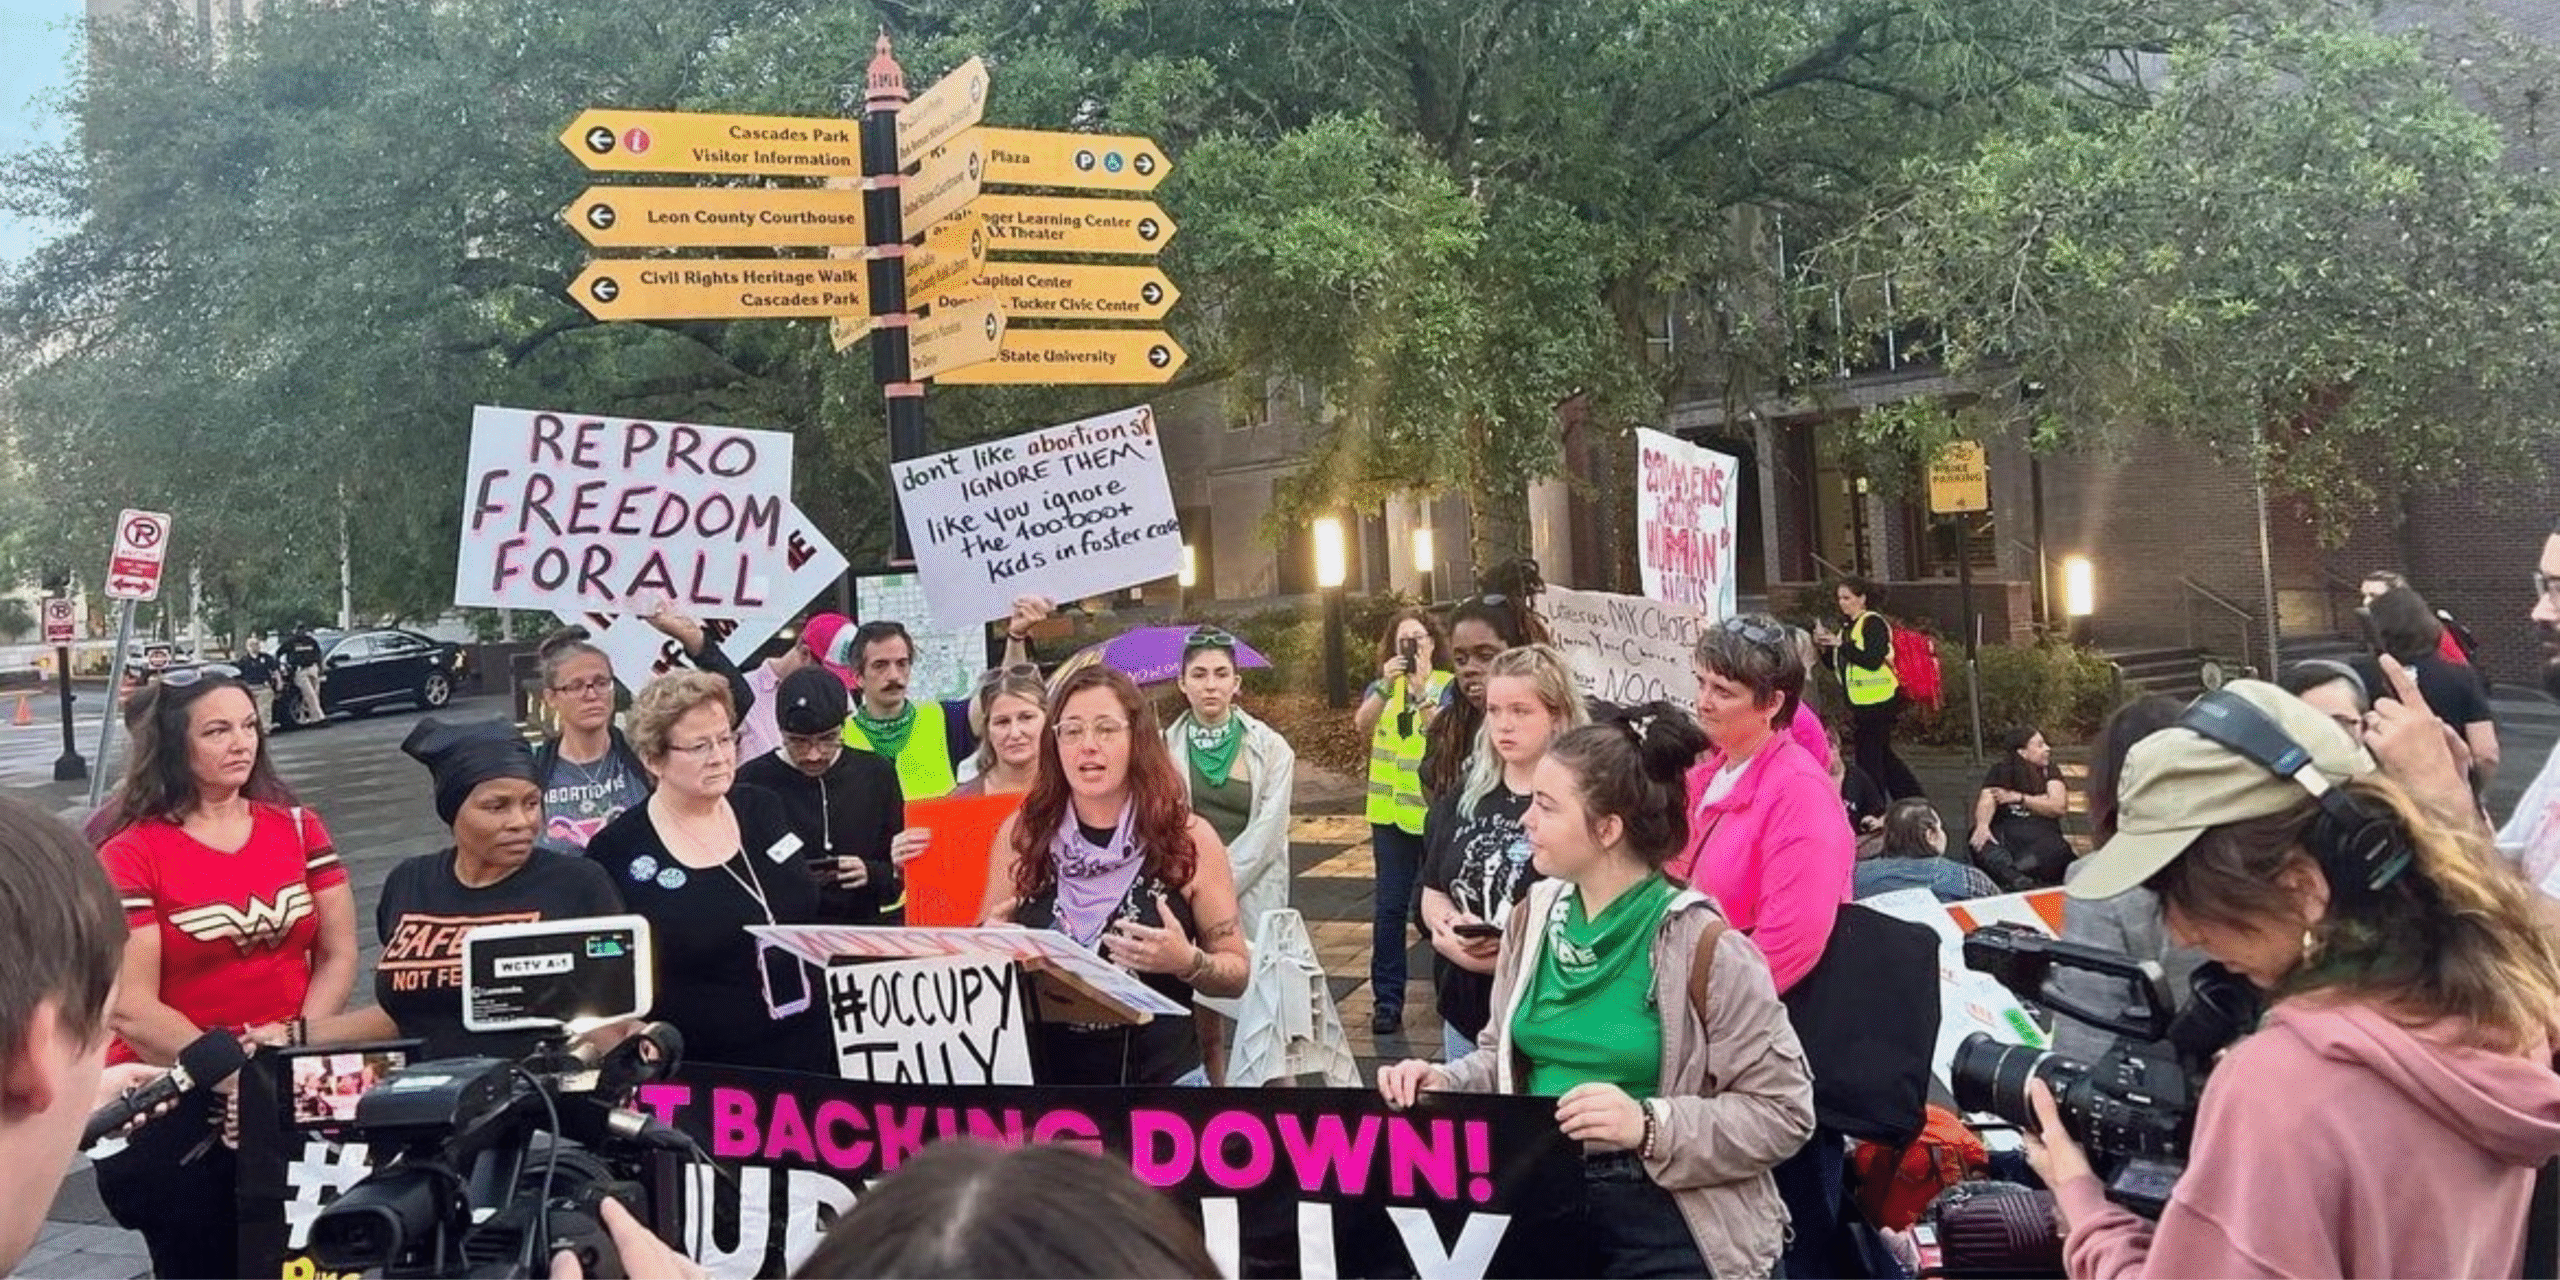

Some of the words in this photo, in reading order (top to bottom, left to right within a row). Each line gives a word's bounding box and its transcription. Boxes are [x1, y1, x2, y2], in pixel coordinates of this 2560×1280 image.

[729, 126, 808, 142] Cascades
[813, 127, 850, 143] Park
[692, 148, 750, 165] Visitor
[754, 150, 851, 167] Information
[991, 149, 1031, 165] Plaza
[647, 210, 690, 225] Leon
[694, 210, 755, 228] County
[759, 210, 855, 226] Courthouse
[1017, 212, 1082, 229] Learning
[1086, 213, 1132, 228] Center
[1010, 227, 1065, 241] Theater
[640, 270, 680, 285] Civil
[684, 270, 739, 288] Rights
[743, 269, 813, 288] Heritage
[818, 268, 858, 283] Walk
[1027, 275, 1073, 288] Center
[741, 293, 818, 307] Cascades
[822, 291, 860, 306] Park
[1011, 298, 1056, 312] Tucker
[1060, 298, 1093, 312] Civic
[1096, 299, 1141, 313] Center
[1000, 350, 1041, 363] State
[1044, 350, 1117, 366] University
[529, 413, 757, 478] REPRO
[902, 453, 962, 492] don't
[974, 446, 1017, 472] like
[961, 460, 1050, 502] IGNORE
[472, 469, 781, 547] FREEDOM
[927, 515, 980, 545] like
[984, 501, 1031, 532] you
[1043, 479, 1126, 520] ignore
[961, 534, 1012, 559] the
[1055, 544, 1077, 560] in
[1081, 526, 1142, 555] foster
[492, 538, 616, 601] FOR
[625, 550, 764, 607] ALL
[1605, 667, 1645, 703] NO
[502, 961, 542, 972] WCTV
[393, 970, 432, 992] NOT
[830, 962, 1013, 1035] #OCCUPY
[1130, 1108, 1493, 1203] DOWN!
